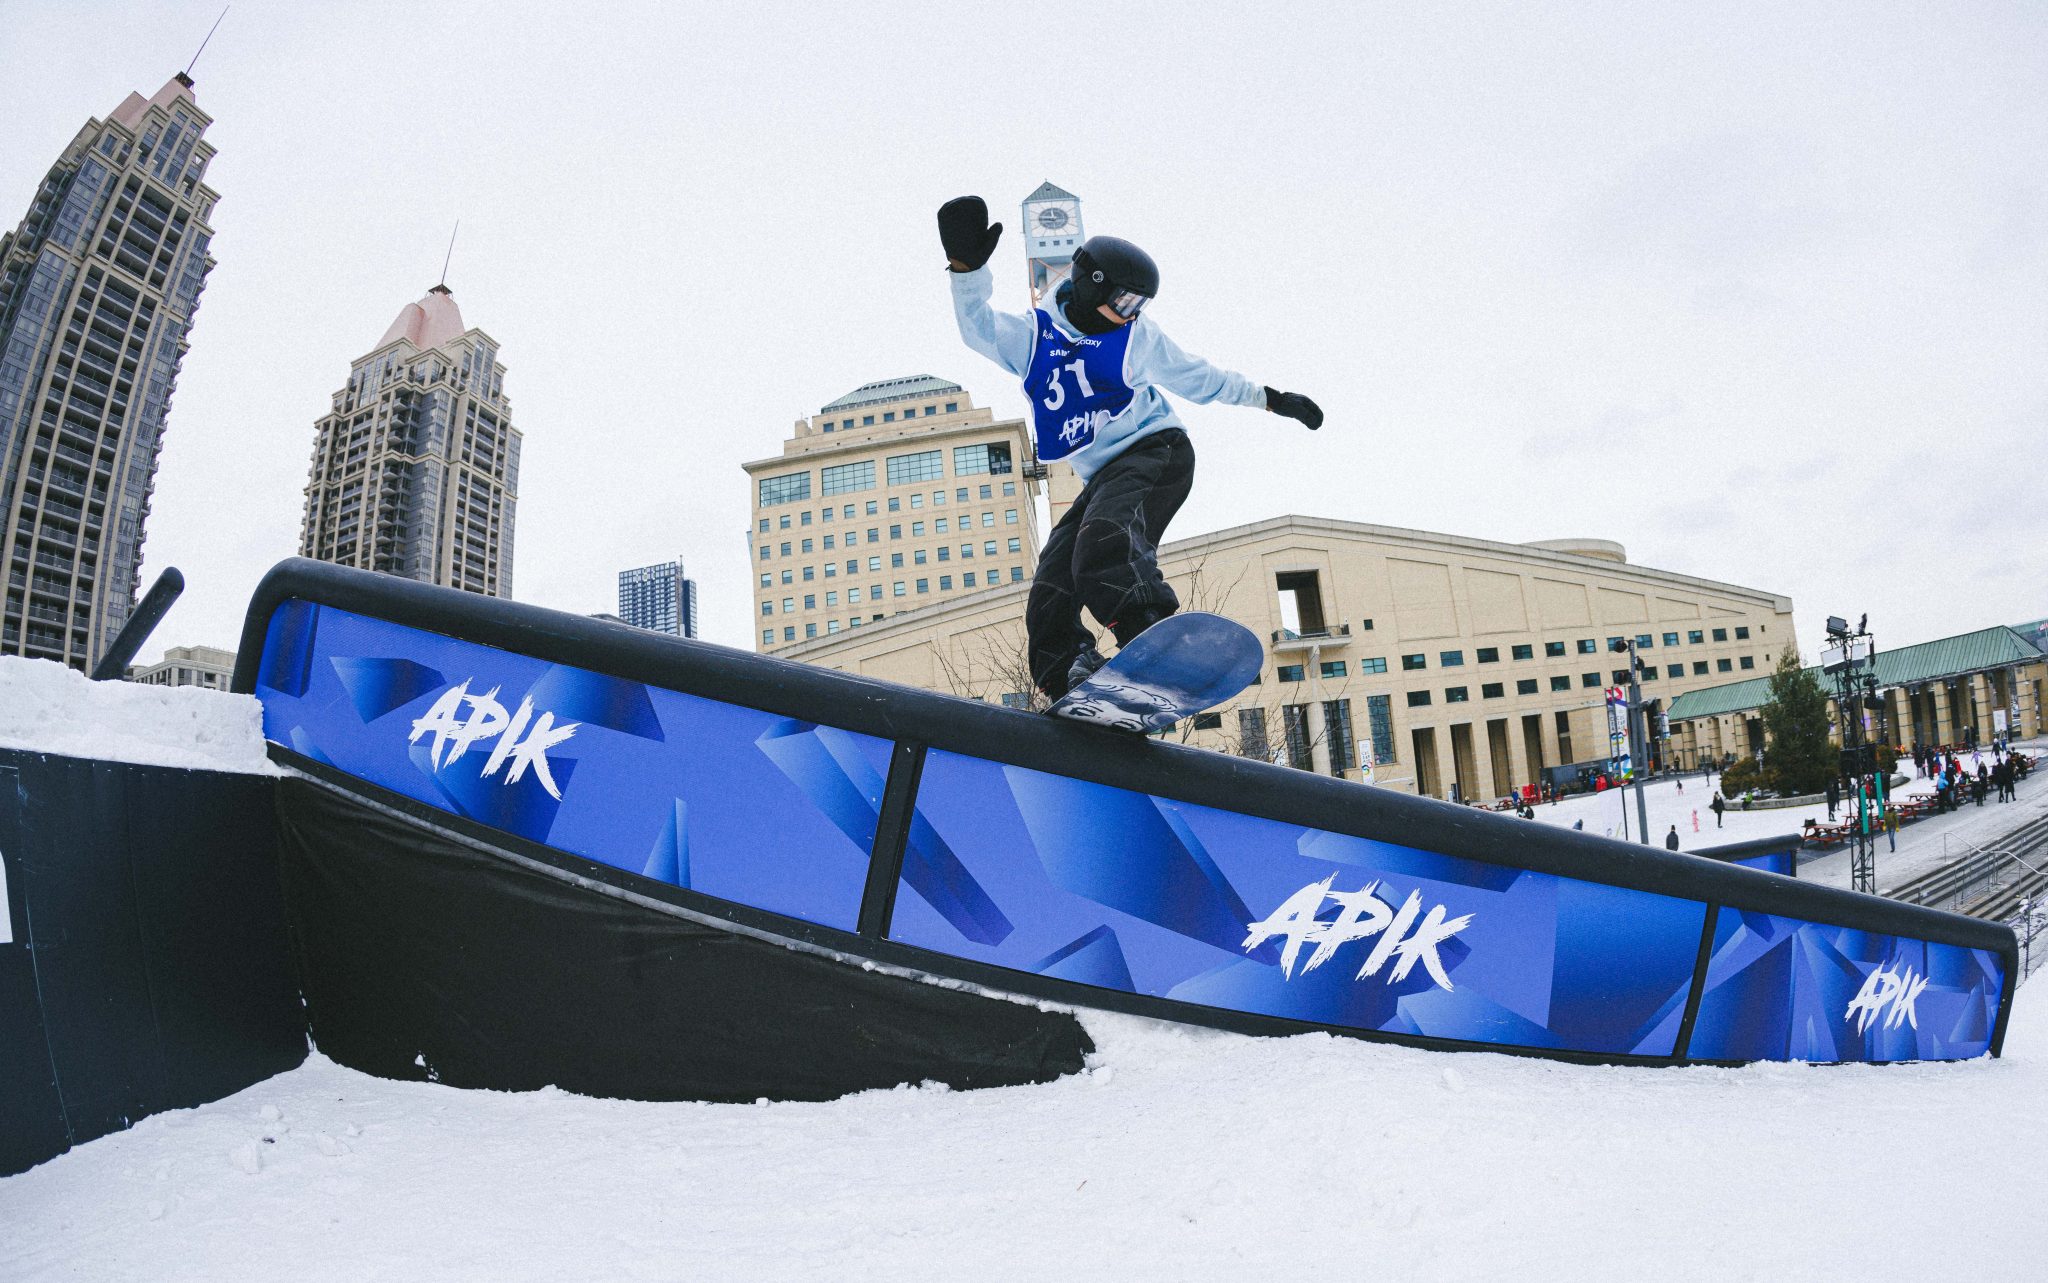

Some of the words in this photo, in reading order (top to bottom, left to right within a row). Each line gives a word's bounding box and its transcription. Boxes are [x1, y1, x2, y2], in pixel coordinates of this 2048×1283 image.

[1043, 358, 1095, 411] 31
[408, 676, 582, 802] APIK
[1241, 870, 1477, 993] APIK
[1844, 960, 1930, 1037] APIK
